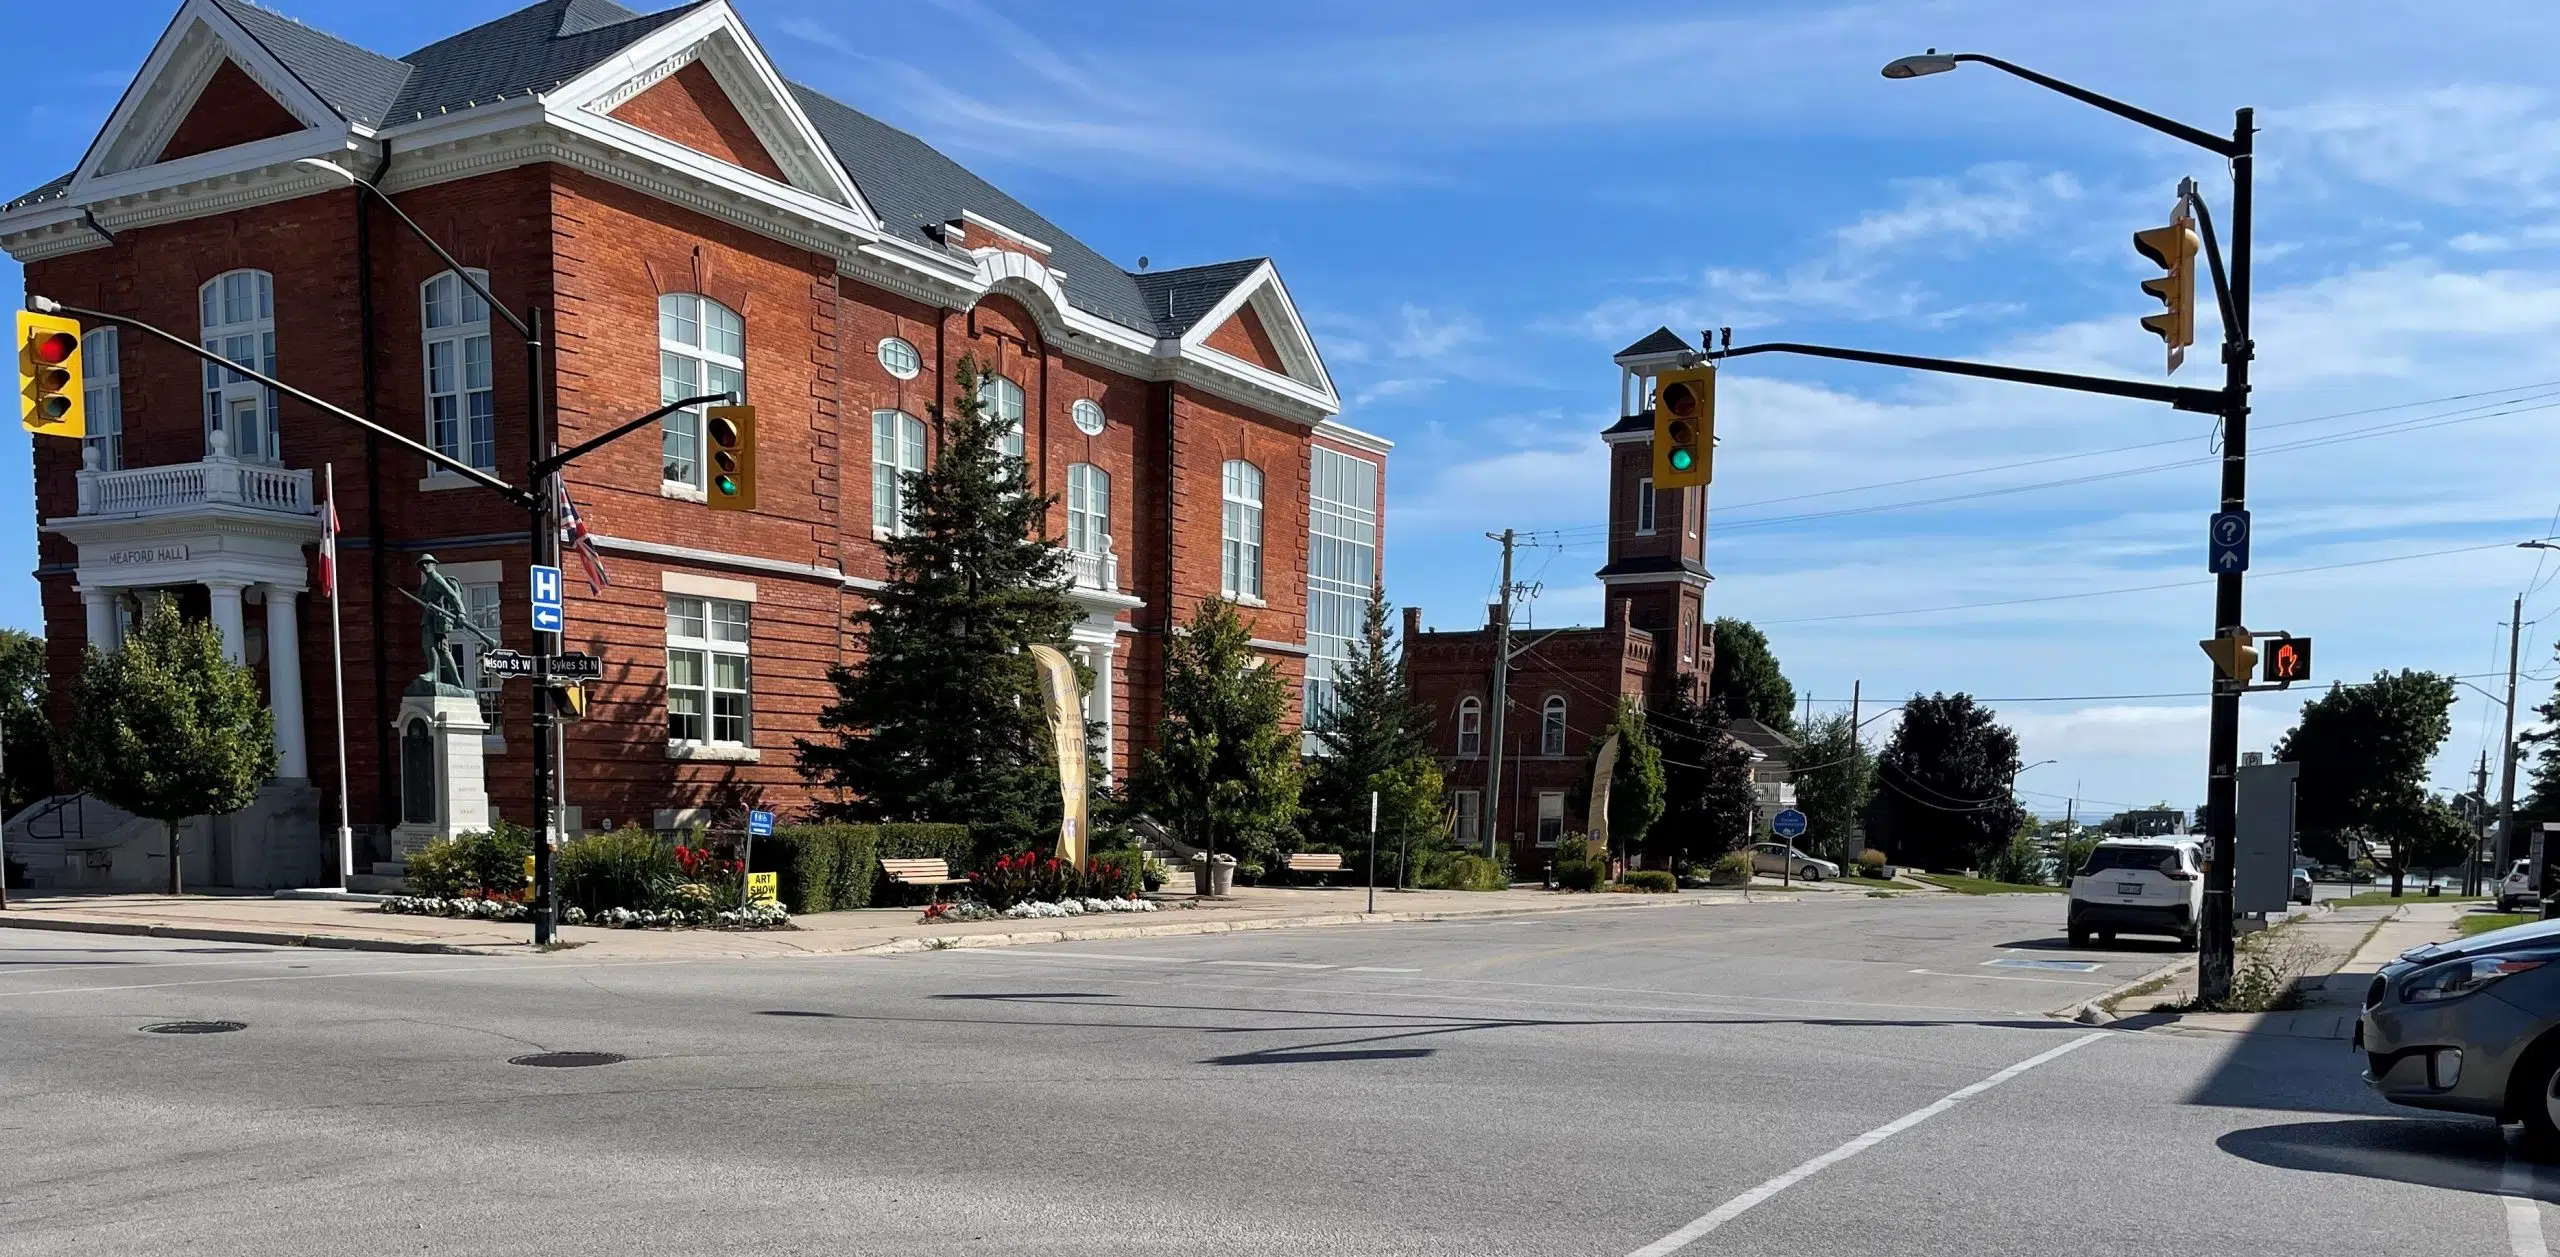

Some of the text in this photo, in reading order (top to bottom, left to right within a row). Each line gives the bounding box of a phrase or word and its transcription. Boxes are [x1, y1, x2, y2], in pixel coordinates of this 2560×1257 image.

[109, 547, 182, 564] MEAFORD HALL
[537, 571, 556, 600] H
[510, 659, 520, 670] St
[522, 660, 531, 670] W
[551, 660, 598, 672] Sykes St N
[1058, 732, 1083, 753] ilm
[755, 874, 772, 884] ART
[750, 885, 776, 895] SHOW
